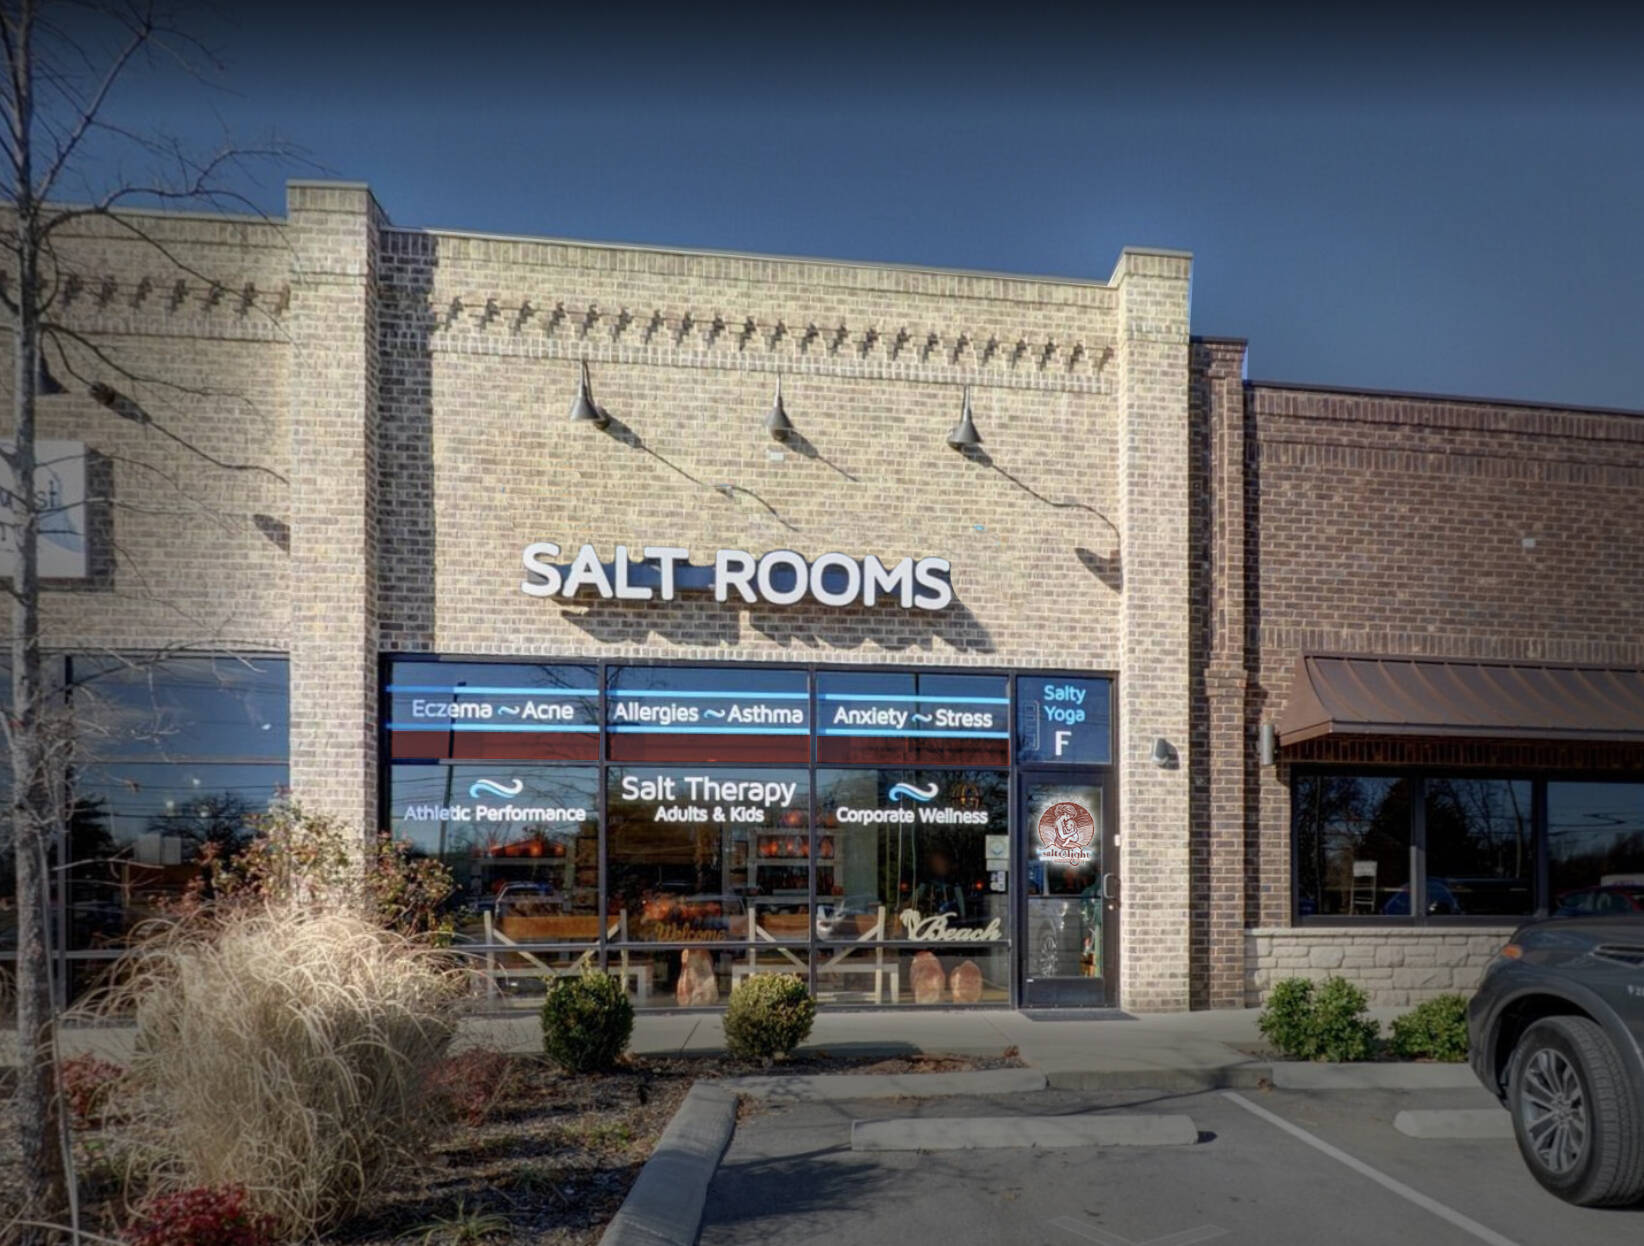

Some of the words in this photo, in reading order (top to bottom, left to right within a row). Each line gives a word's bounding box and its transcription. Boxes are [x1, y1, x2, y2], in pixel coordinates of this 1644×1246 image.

[521, 542, 689, 600] SALT
[715, 549, 952, 610] ROOMS
[1045, 685, 1086, 704] Salty
[413, 700, 493, 718] Eczema
[522, 701, 574, 719] Acne
[614, 702, 699, 725] Allergies
[728, 705, 803, 723] Asthma
[834, 707, 909, 729] Anxiety
[936, 709, 992, 727] Stress
[1044, 706, 1085, 725] Yoga
[1056, 731, 1071, 755] F
[622, 776, 675, 800] Salt
[684, 776, 796, 807] Therapy
[404, 805, 471, 821] Athletic
[476, 805, 586, 821] Performance
[655, 806, 708, 822] Adults
[713, 806, 725, 822] &
[730, 806, 764, 822] Kids
[836, 807, 915, 825] Corporate
[919, 808, 988, 824] Wellness
[914, 911, 1002, 941] Beach
